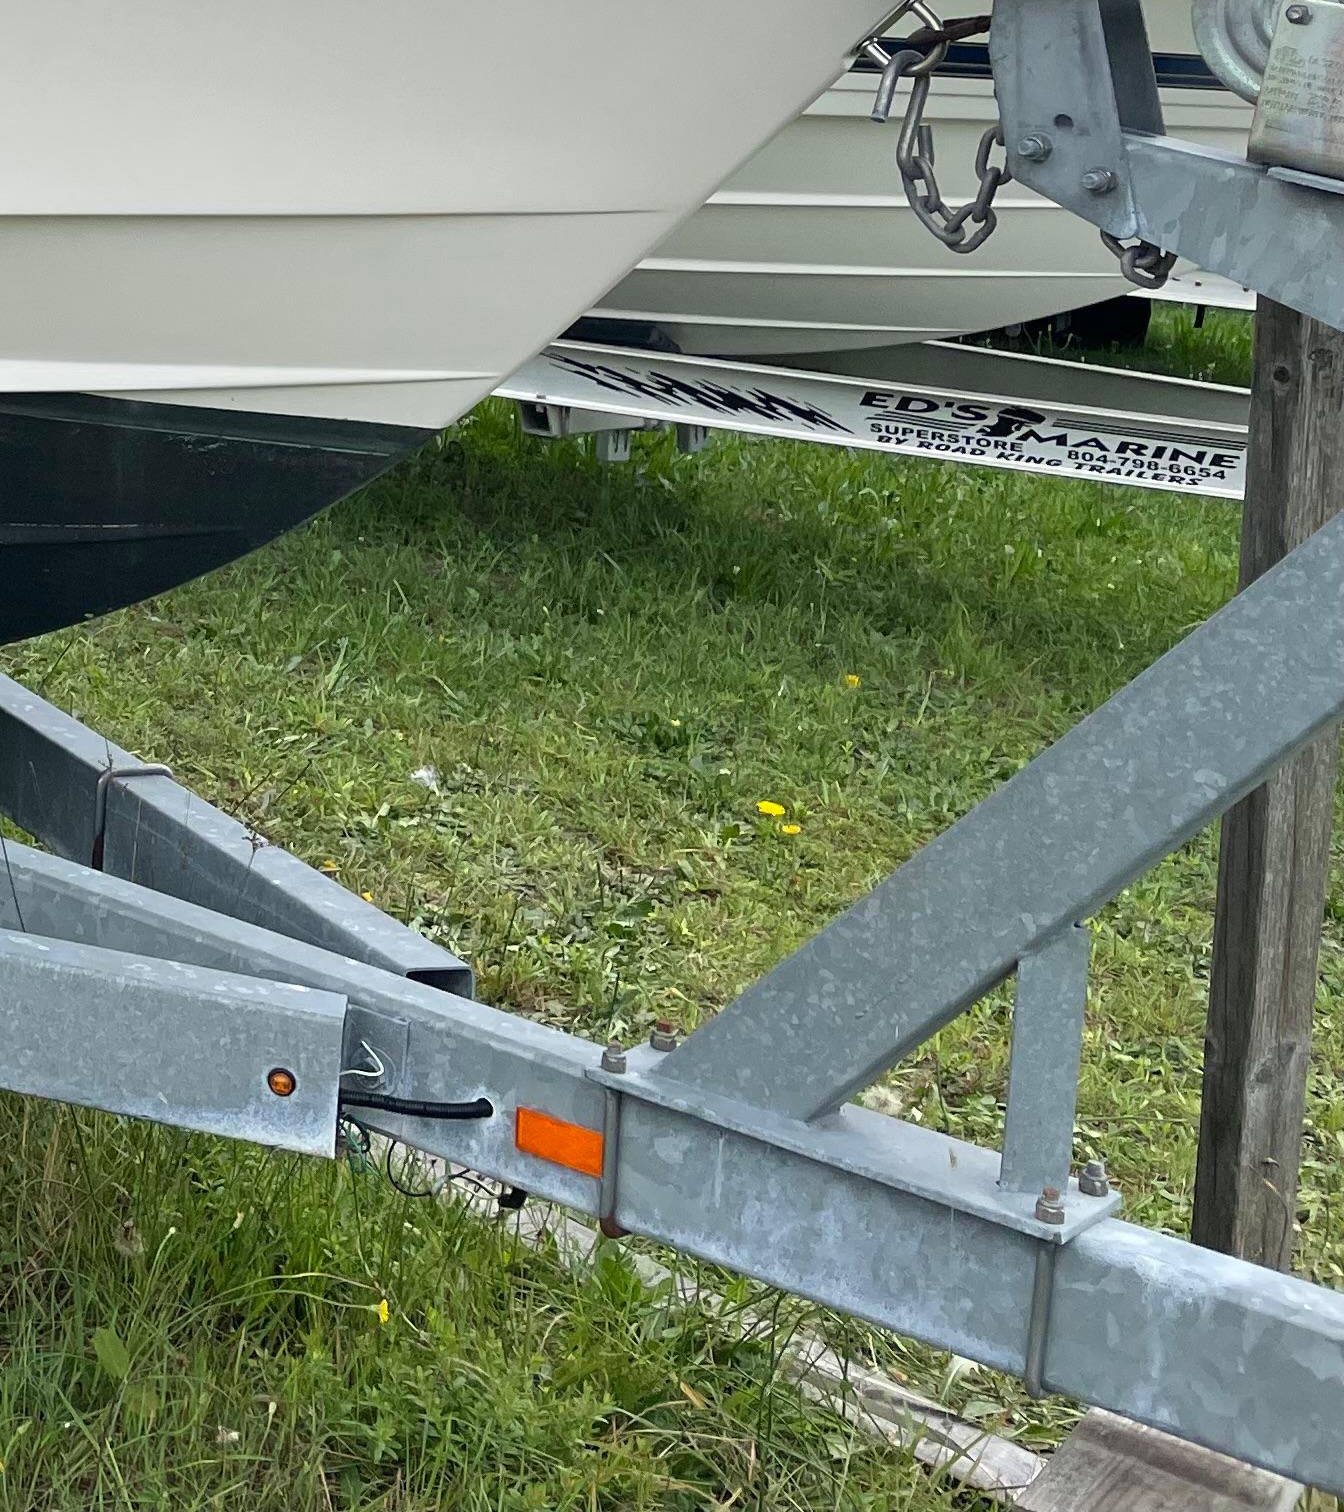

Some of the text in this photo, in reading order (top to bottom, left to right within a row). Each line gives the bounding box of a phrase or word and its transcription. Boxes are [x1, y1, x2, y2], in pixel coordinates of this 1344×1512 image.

[859, 391, 1241, 469] ED'S MARINE
[870, 422, 1226, 480] SUPERSTORE 804-798-6654
[876, 434, 1203, 486] BY ROAD KING TRAILERS
